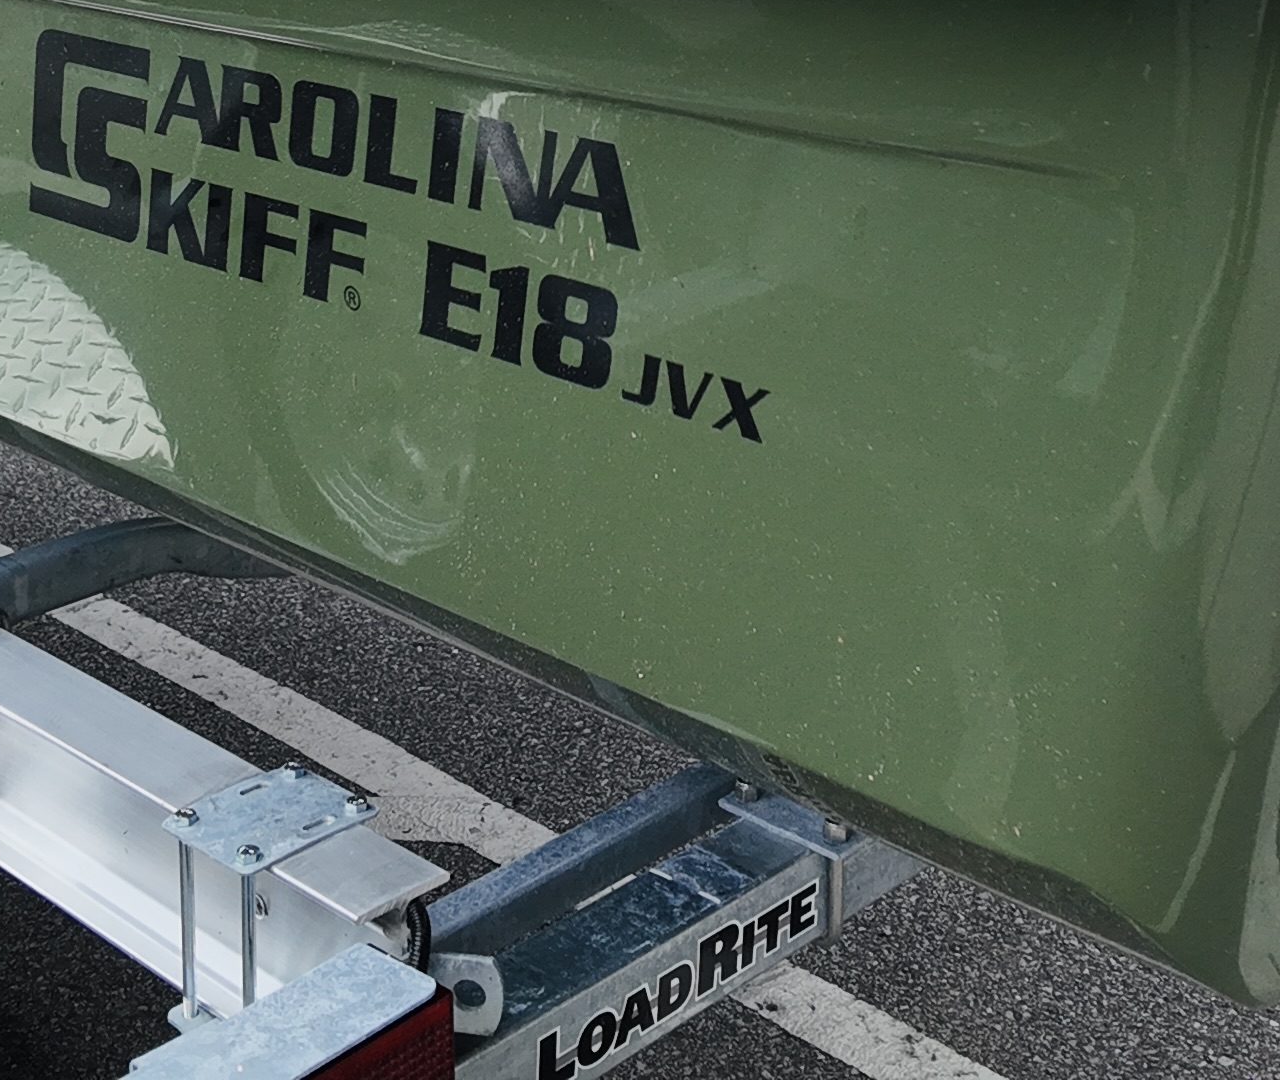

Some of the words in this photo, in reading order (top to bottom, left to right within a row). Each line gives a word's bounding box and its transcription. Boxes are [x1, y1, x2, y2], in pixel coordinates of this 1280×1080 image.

[31, 27, 641, 252] CAROLINA
[419, 239, 618, 389] E18
[621, 354, 771, 444] JVX
[537, 879, 819, 1080] LOADRITE
